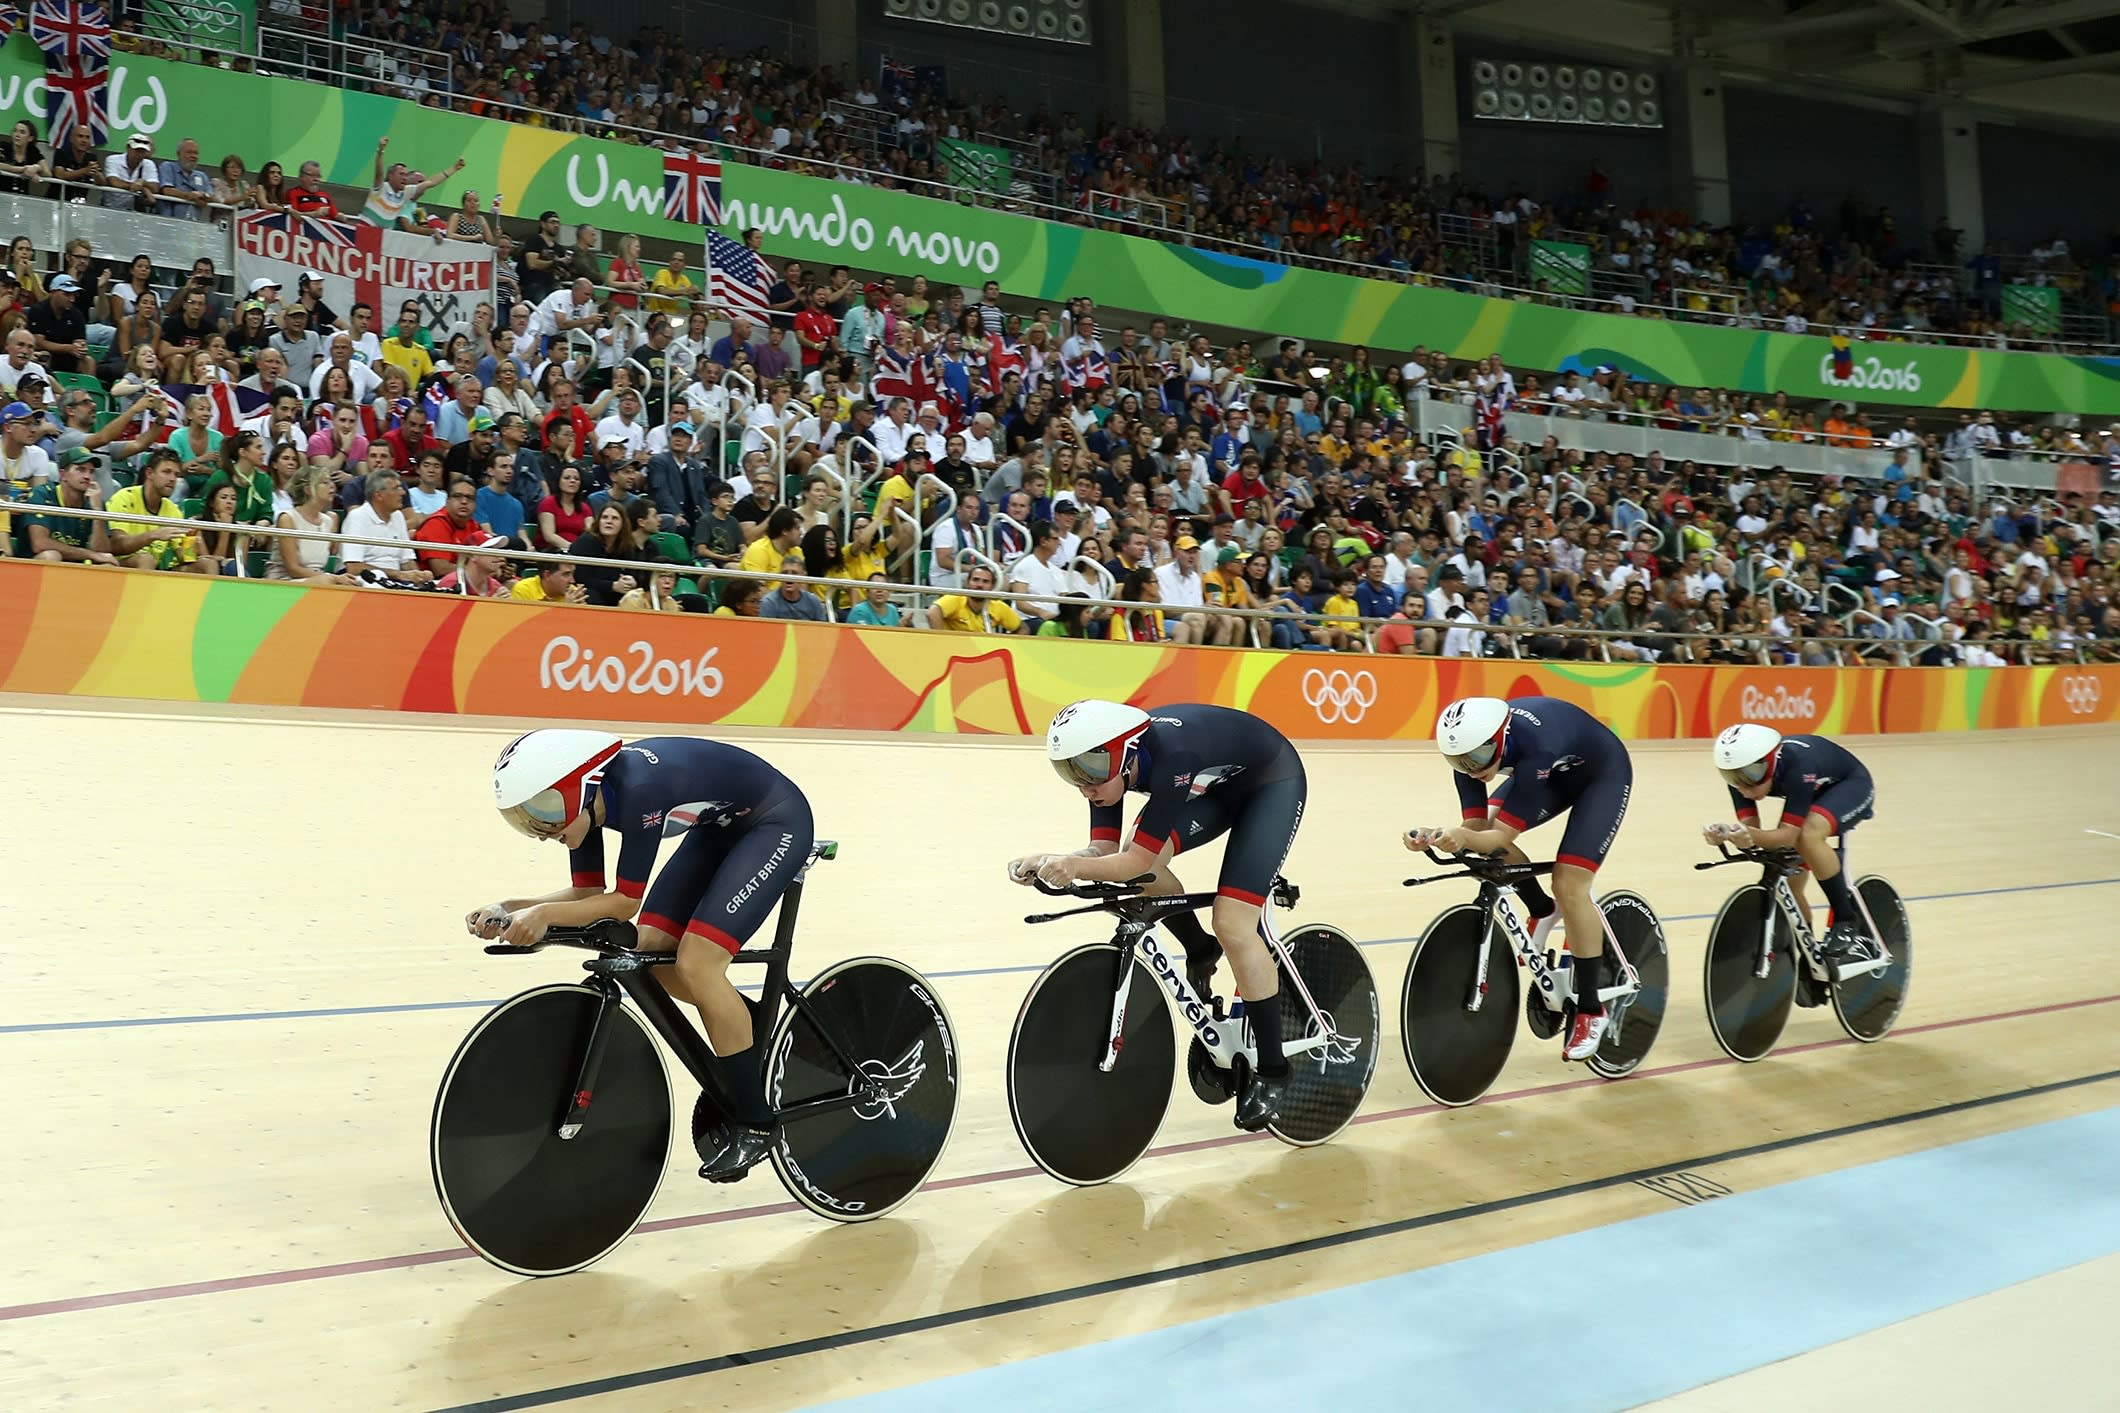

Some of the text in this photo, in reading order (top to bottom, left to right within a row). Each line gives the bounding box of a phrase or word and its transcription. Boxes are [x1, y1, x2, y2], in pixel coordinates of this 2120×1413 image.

[241, 222, 479, 291] HORNCHURCH
[886, 226, 1000, 274] novo
[540, 635, 724, 698] Rio2016
[1741, 685, 1816, 720] Rio2016
[726, 832, 793, 914] GREAT BRITAIN
